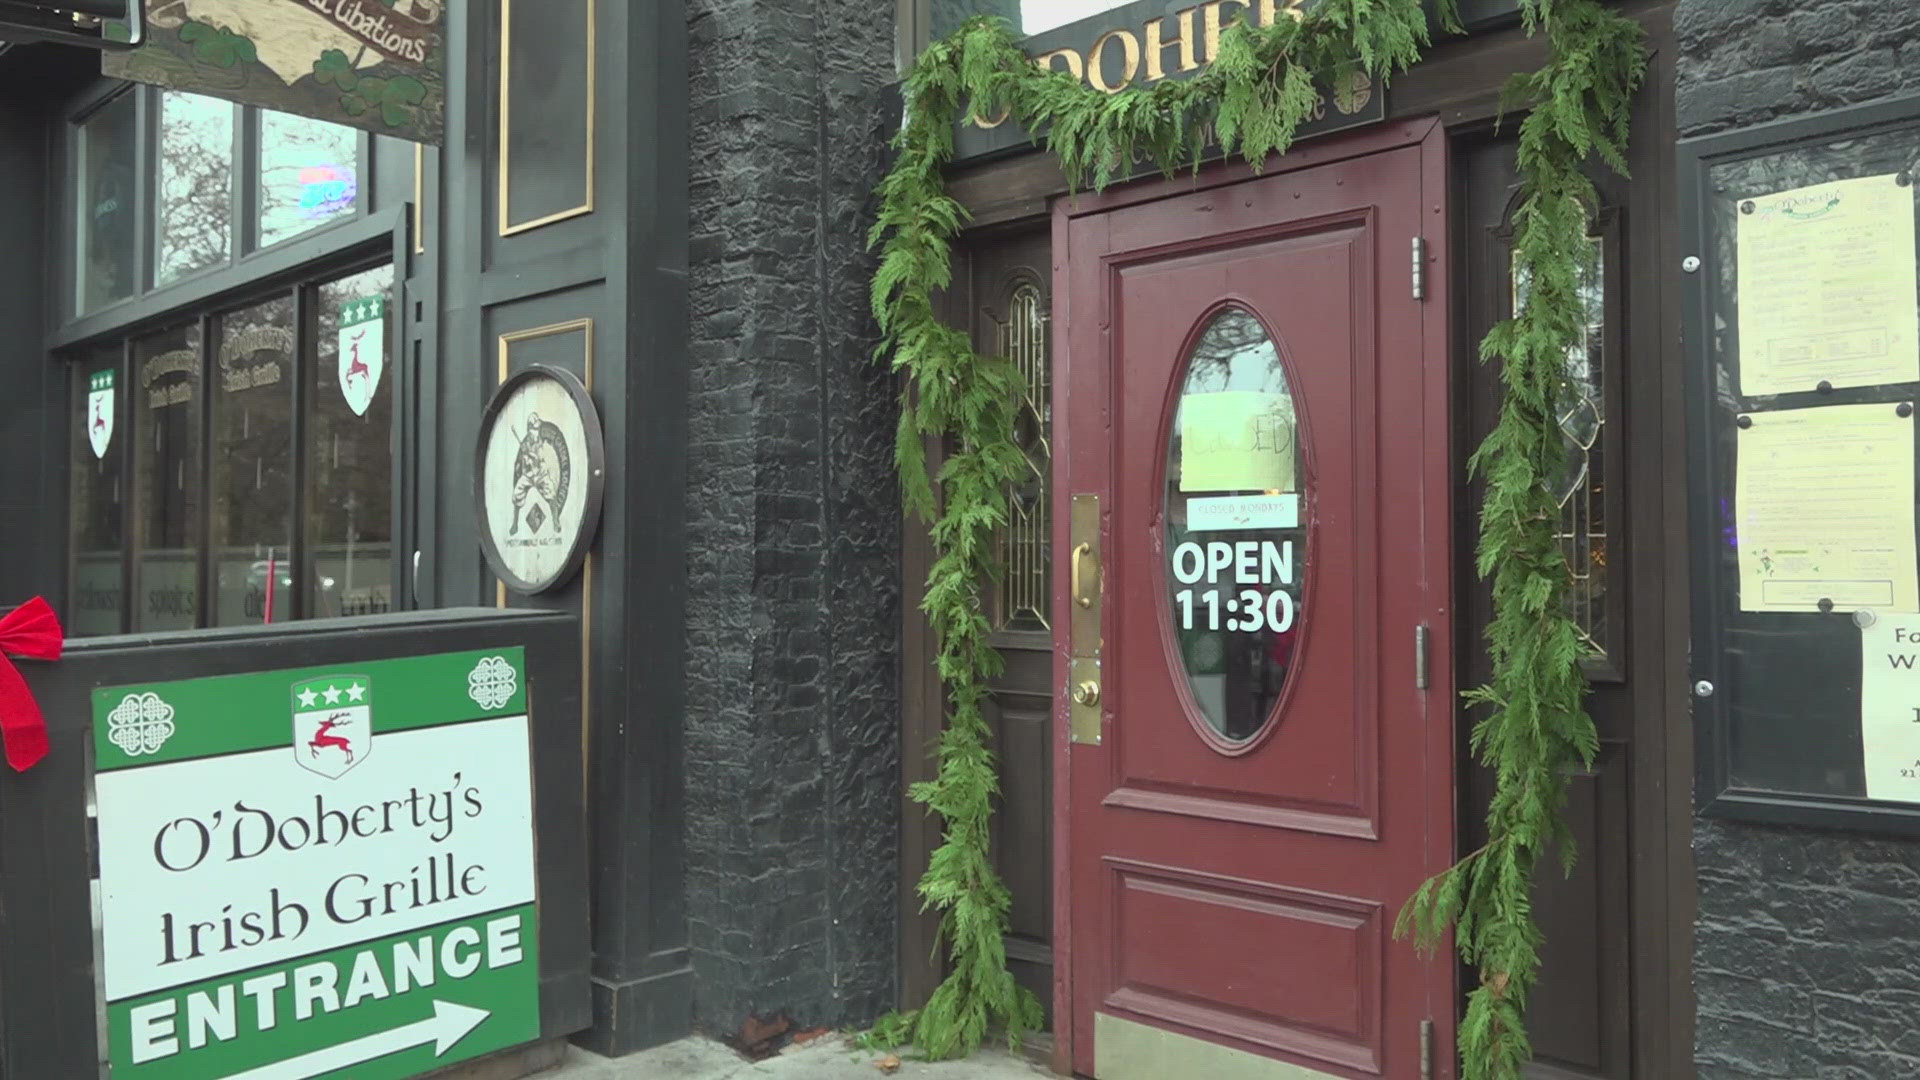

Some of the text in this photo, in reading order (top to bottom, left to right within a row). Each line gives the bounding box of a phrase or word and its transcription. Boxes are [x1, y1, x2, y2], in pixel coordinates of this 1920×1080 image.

[1172, 541, 1293, 584] OPEN
[1176, 589, 1294, 633] 11:30
[153, 771, 483, 872] O'Doherty's
[157, 852, 487, 966] Irish Grille
[130, 914, 523, 1065] ENTRANCE
